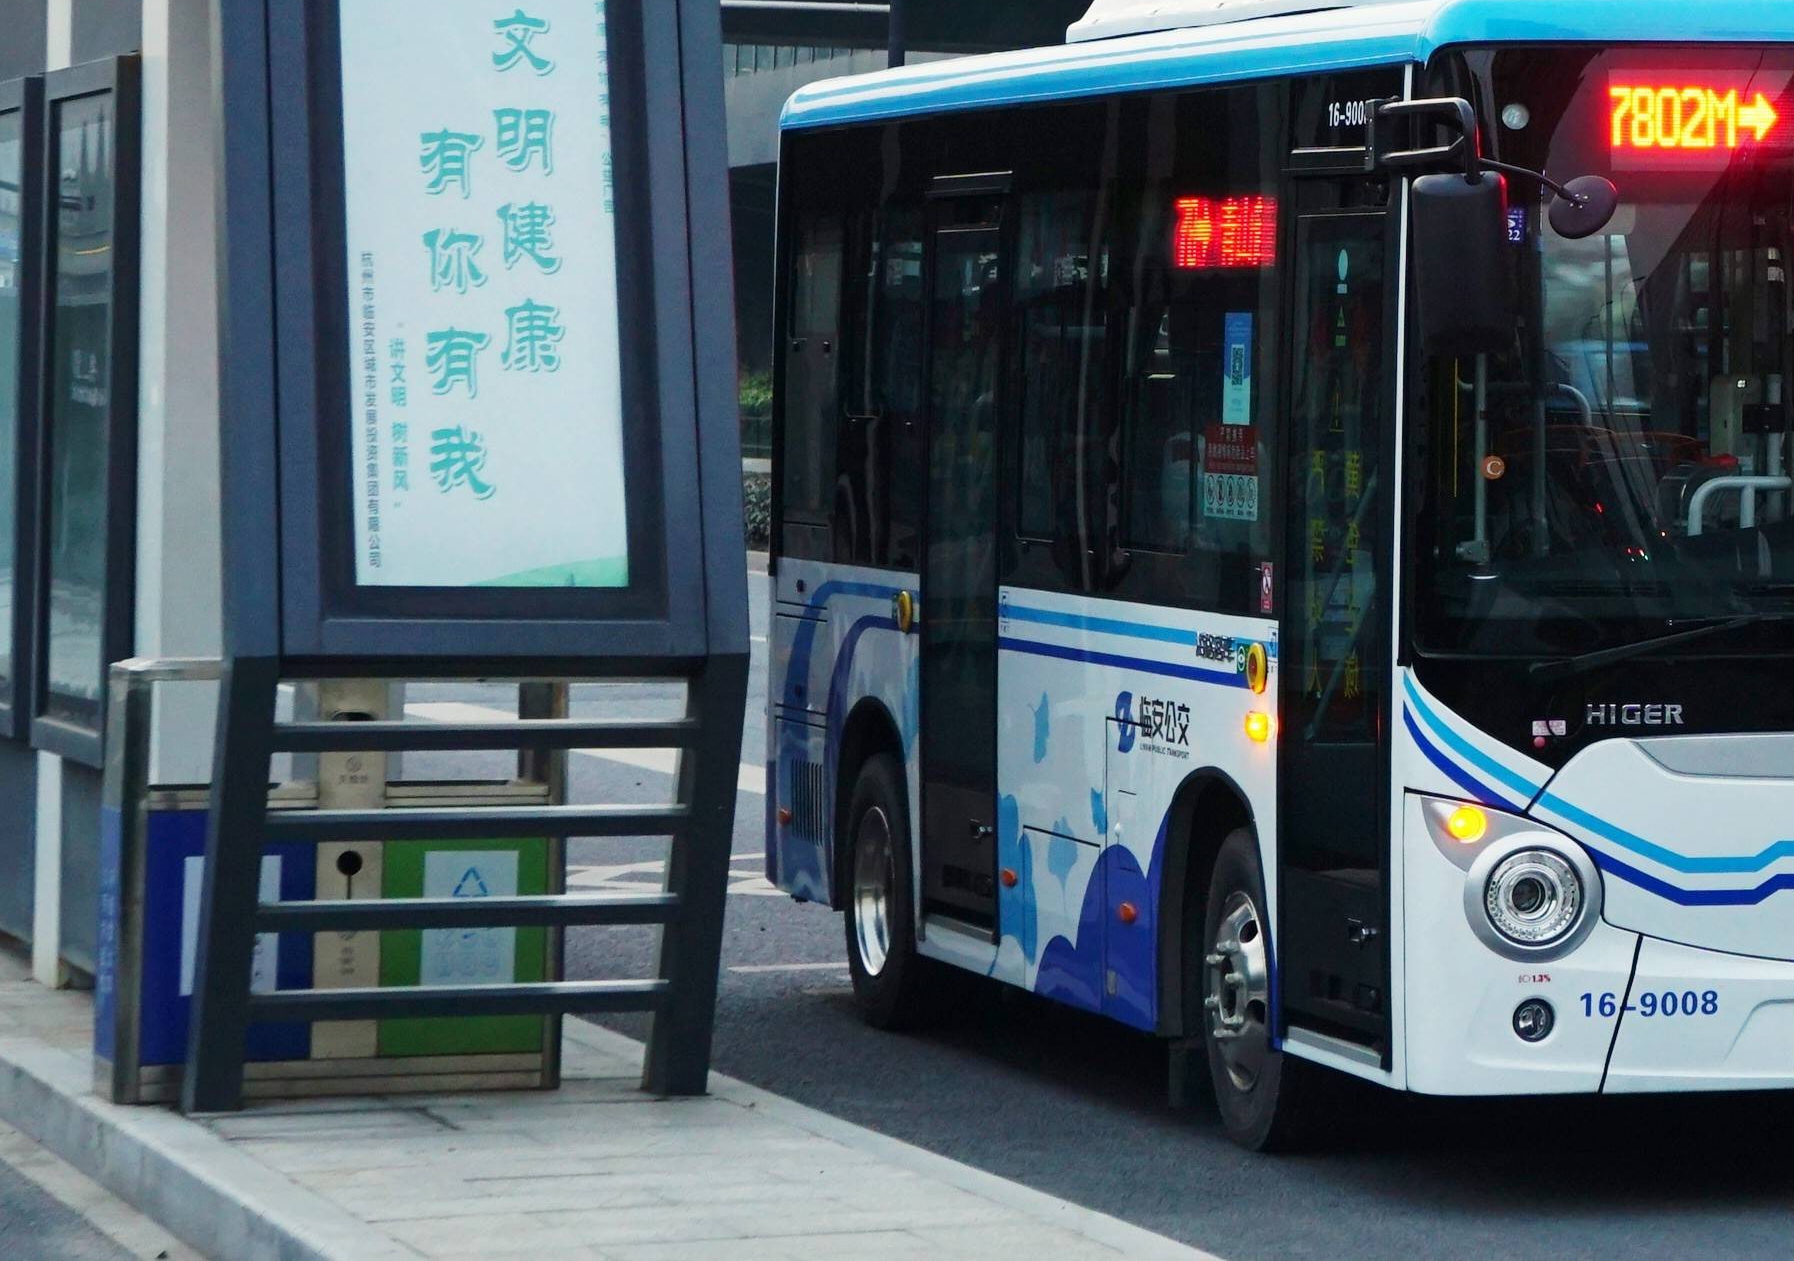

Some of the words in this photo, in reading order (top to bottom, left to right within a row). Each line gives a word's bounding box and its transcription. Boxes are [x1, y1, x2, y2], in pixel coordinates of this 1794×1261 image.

[1328, 100, 1367, 127] 16-900
[1608, 85, 1737, 150] 7802M
[492, 9, 565, 374] 文明健康
[418, 128, 496, 501] 有你有我
[1139, 695, 1191, 747] 临安公交
[1586, 703, 1686, 726] HIGER
[1579, 989, 1719, 1019] 16-9008
